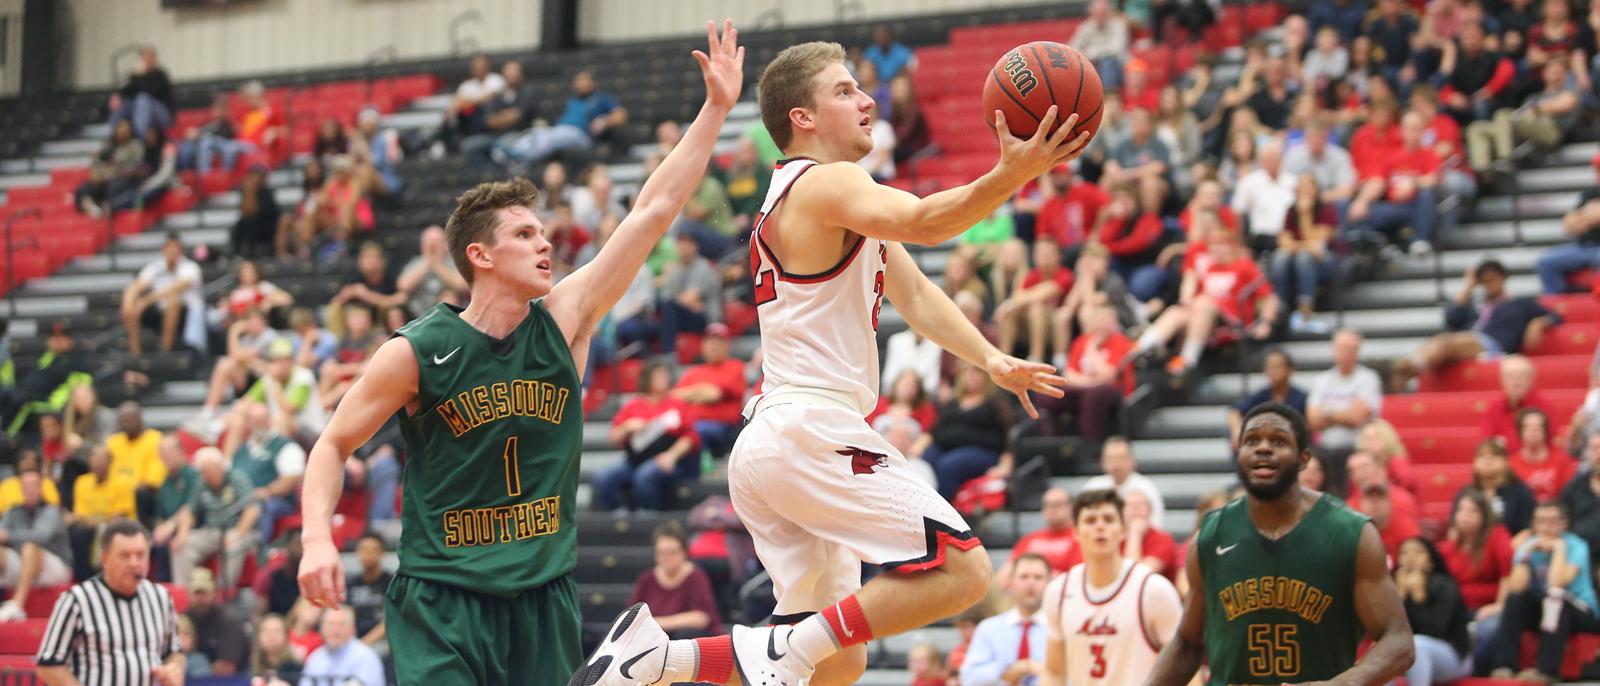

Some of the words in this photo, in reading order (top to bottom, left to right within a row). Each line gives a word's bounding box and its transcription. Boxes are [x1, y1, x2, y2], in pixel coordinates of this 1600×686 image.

[436, 379, 569, 438] MISSOURI
[504, 436, 521, 496] 1
[444, 495, 560, 548] SOUTHER
[1218, 576, 1333, 624] MISSOURI
[1090, 644, 1106, 678] 3
[1248, 624, 1300, 677] 55
